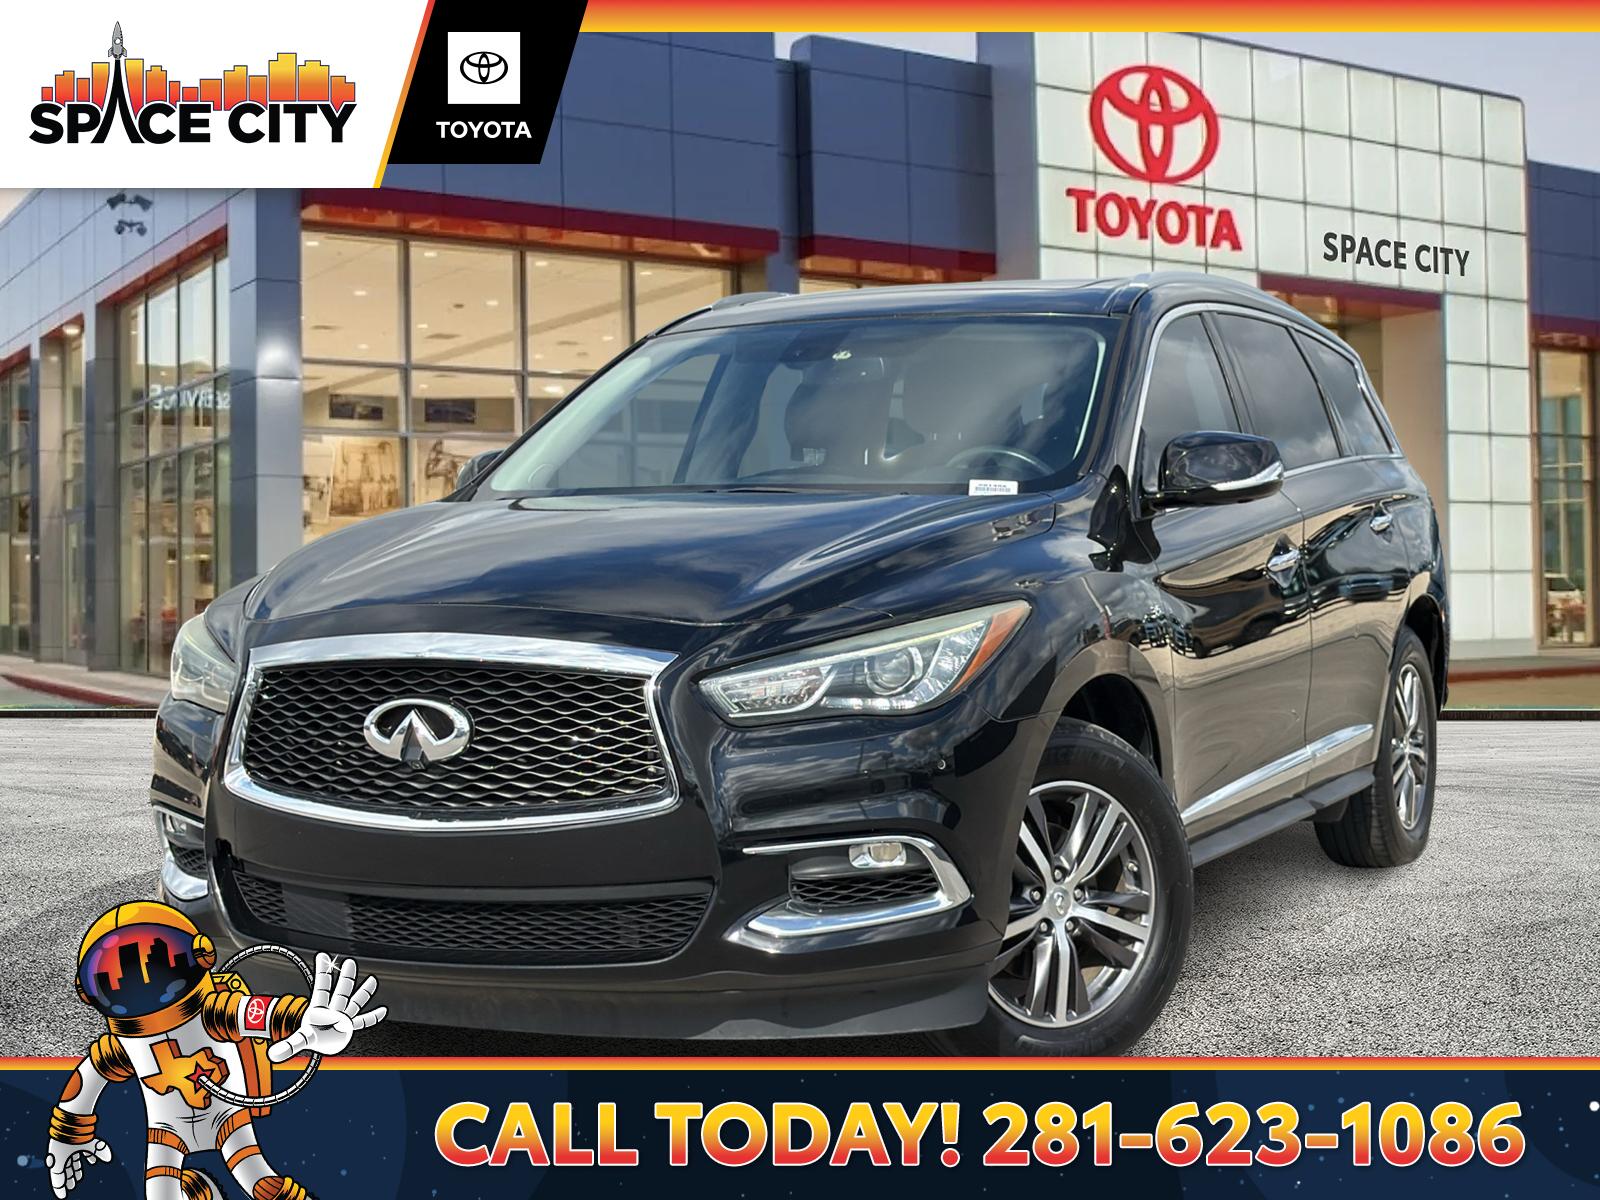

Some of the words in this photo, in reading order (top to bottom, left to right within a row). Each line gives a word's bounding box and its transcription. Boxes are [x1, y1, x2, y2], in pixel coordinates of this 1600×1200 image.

[1066, 187, 1243, 251] TOYOTA
[1322, 231, 1408, 270] SPACE
[1414, 243, 1471, 277] CITY
